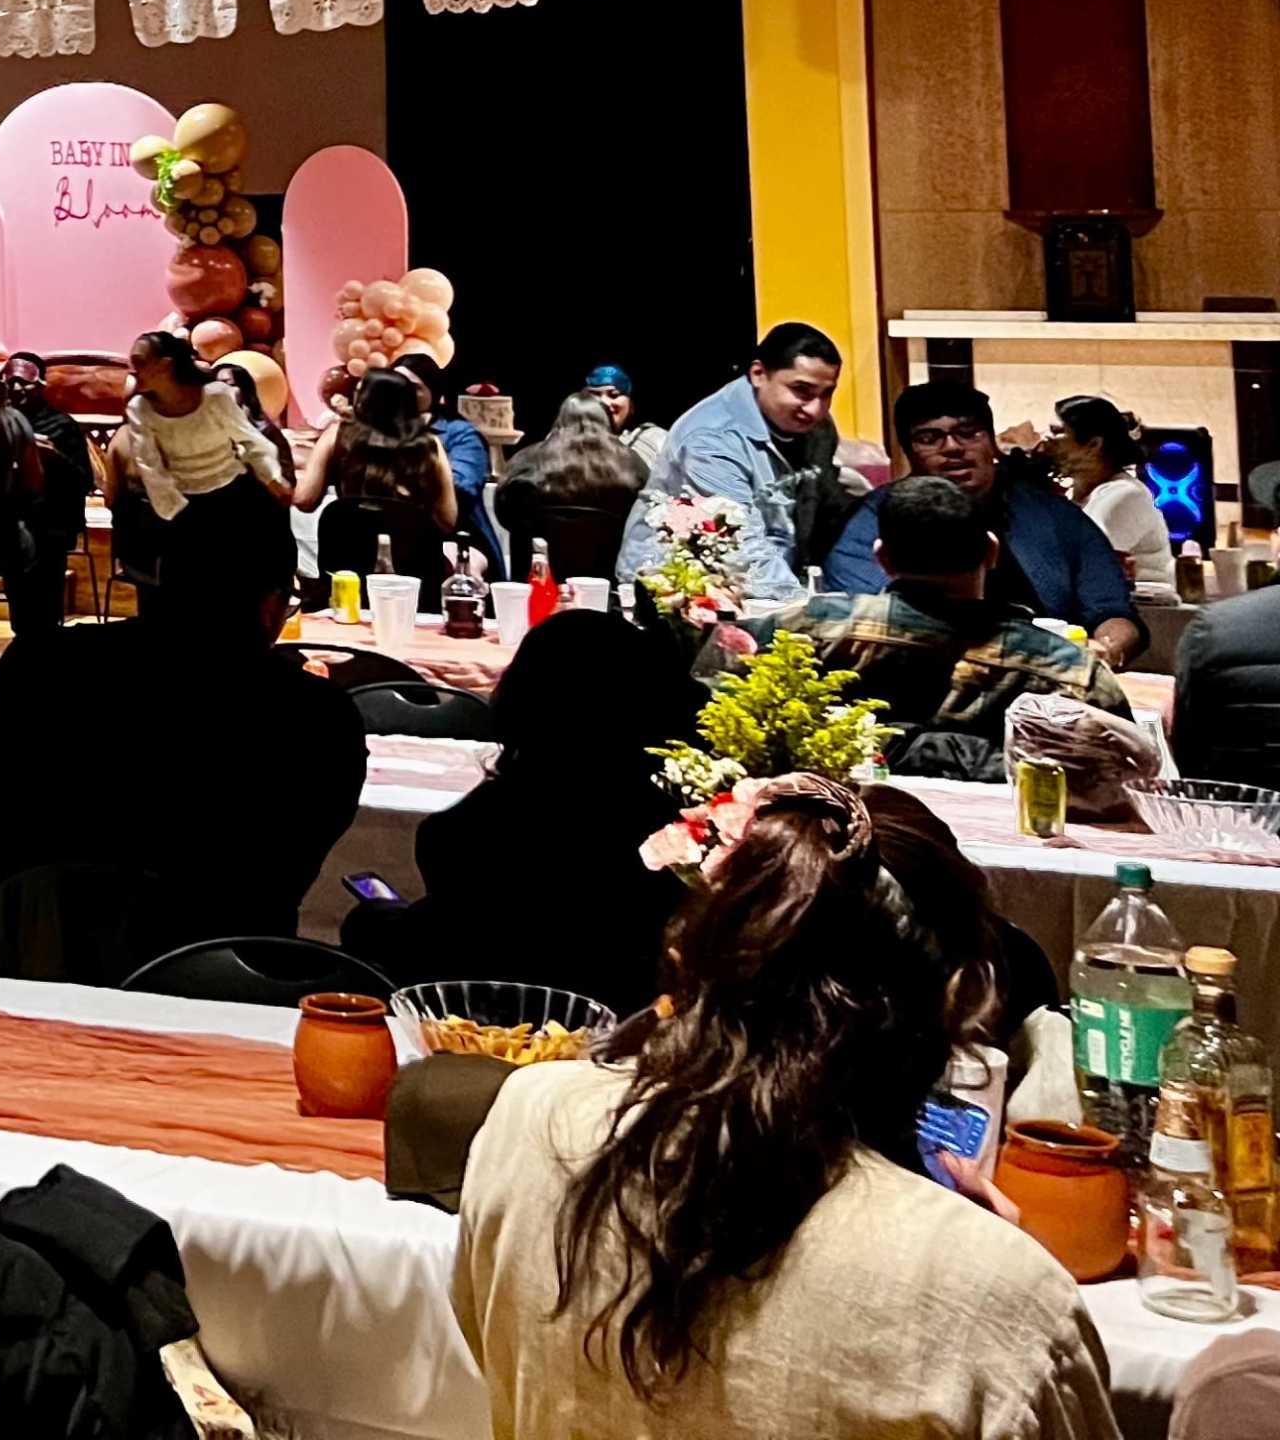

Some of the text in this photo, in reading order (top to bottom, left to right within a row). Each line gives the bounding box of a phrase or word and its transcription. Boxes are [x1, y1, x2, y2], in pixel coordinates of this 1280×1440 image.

[50, 140, 133, 167] BABY IN
[53, 176, 162, 229] Bloom
